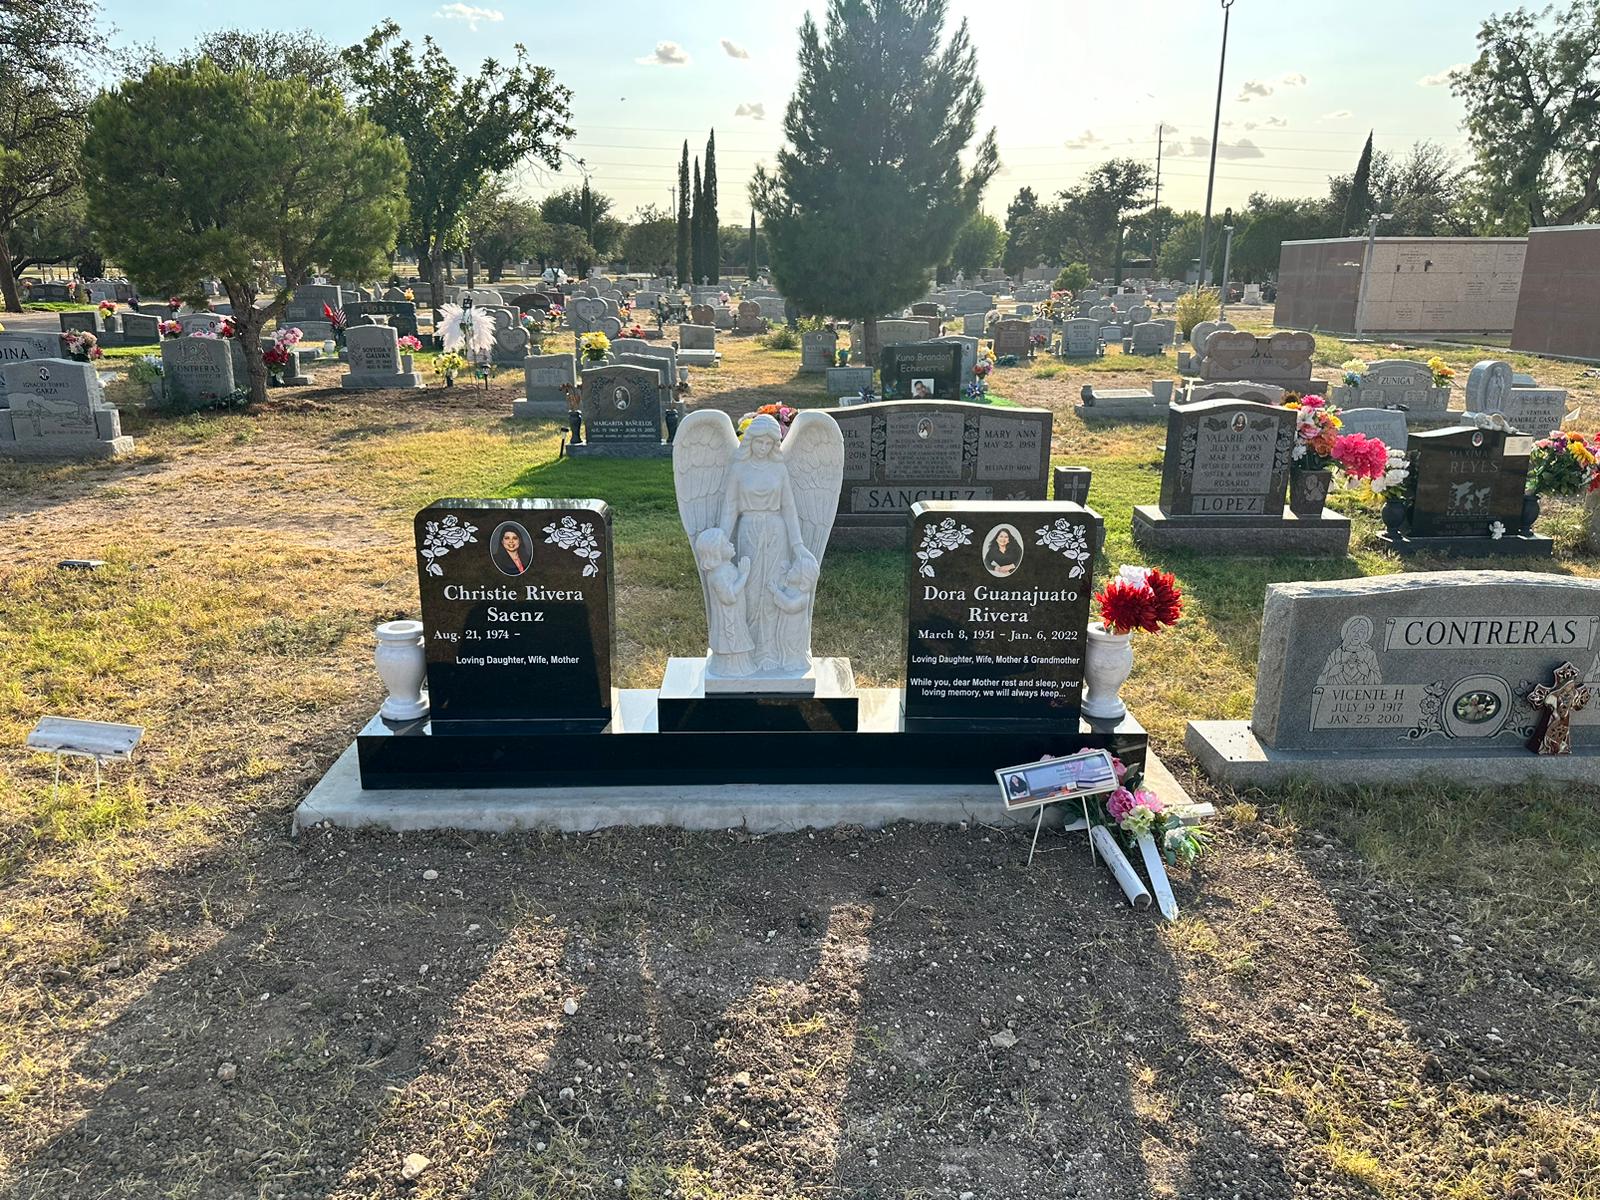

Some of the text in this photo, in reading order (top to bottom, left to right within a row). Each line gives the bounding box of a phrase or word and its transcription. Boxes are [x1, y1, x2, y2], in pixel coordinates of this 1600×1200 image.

[918, 352, 951, 361] Brandon
[1381, 376, 1411, 385] ZUNIGA
[984, 430, 1036, 439] MARY ANN
[1206, 434, 1244, 442] VALARIE
[1210, 444, 1228, 452] JULY
[1449, 448, 1488, 458] MAXIMA
[1450, 460, 1498, 473] REYES
[1202, 498, 1256, 511] LOPEZ
[444, 584, 584, 600] Christie Rivera
[923, 585, 1078, 606] Dora Guanajuato
[487, 606, 544, 622] Saenz
[968, 607, 1028, 623] Rivera
[434, 630, 461, 642] Aug.
[465, 630, 482, 642] 21,
[486, 630, 510, 640] 1974
[918, 630, 954, 639] March
[958, 630, 968, 641] 8,
[973, 630, 995, 640] 1951
[1008, 630, 1032, 642] Jan.
[1036, 630, 1047, 642] 6,
[1051, 630, 1078, 641] 2022
[1404, 620, 1578, 646] CONTRERAS
[456, 656, 580, 666] Loving Daughter, Wife, Mother
[912, 655, 1080, 665] Loving Daughter, Wife, Mother & Grandmother
[910, 678, 1079, 689] While you, dear Mother rest and sleep, your
[922, 688, 946, 698] loving
[948, 690, 982, 698] memory,
[996, 689, 1010, 697] will
[1011, 689, 1038, 698] always
[1332, 689, 1404, 701] VICENTE H
[1330, 702, 1404, 712] JULY 19 1917
[1327, 714, 1403, 724] JAN 25 2001
